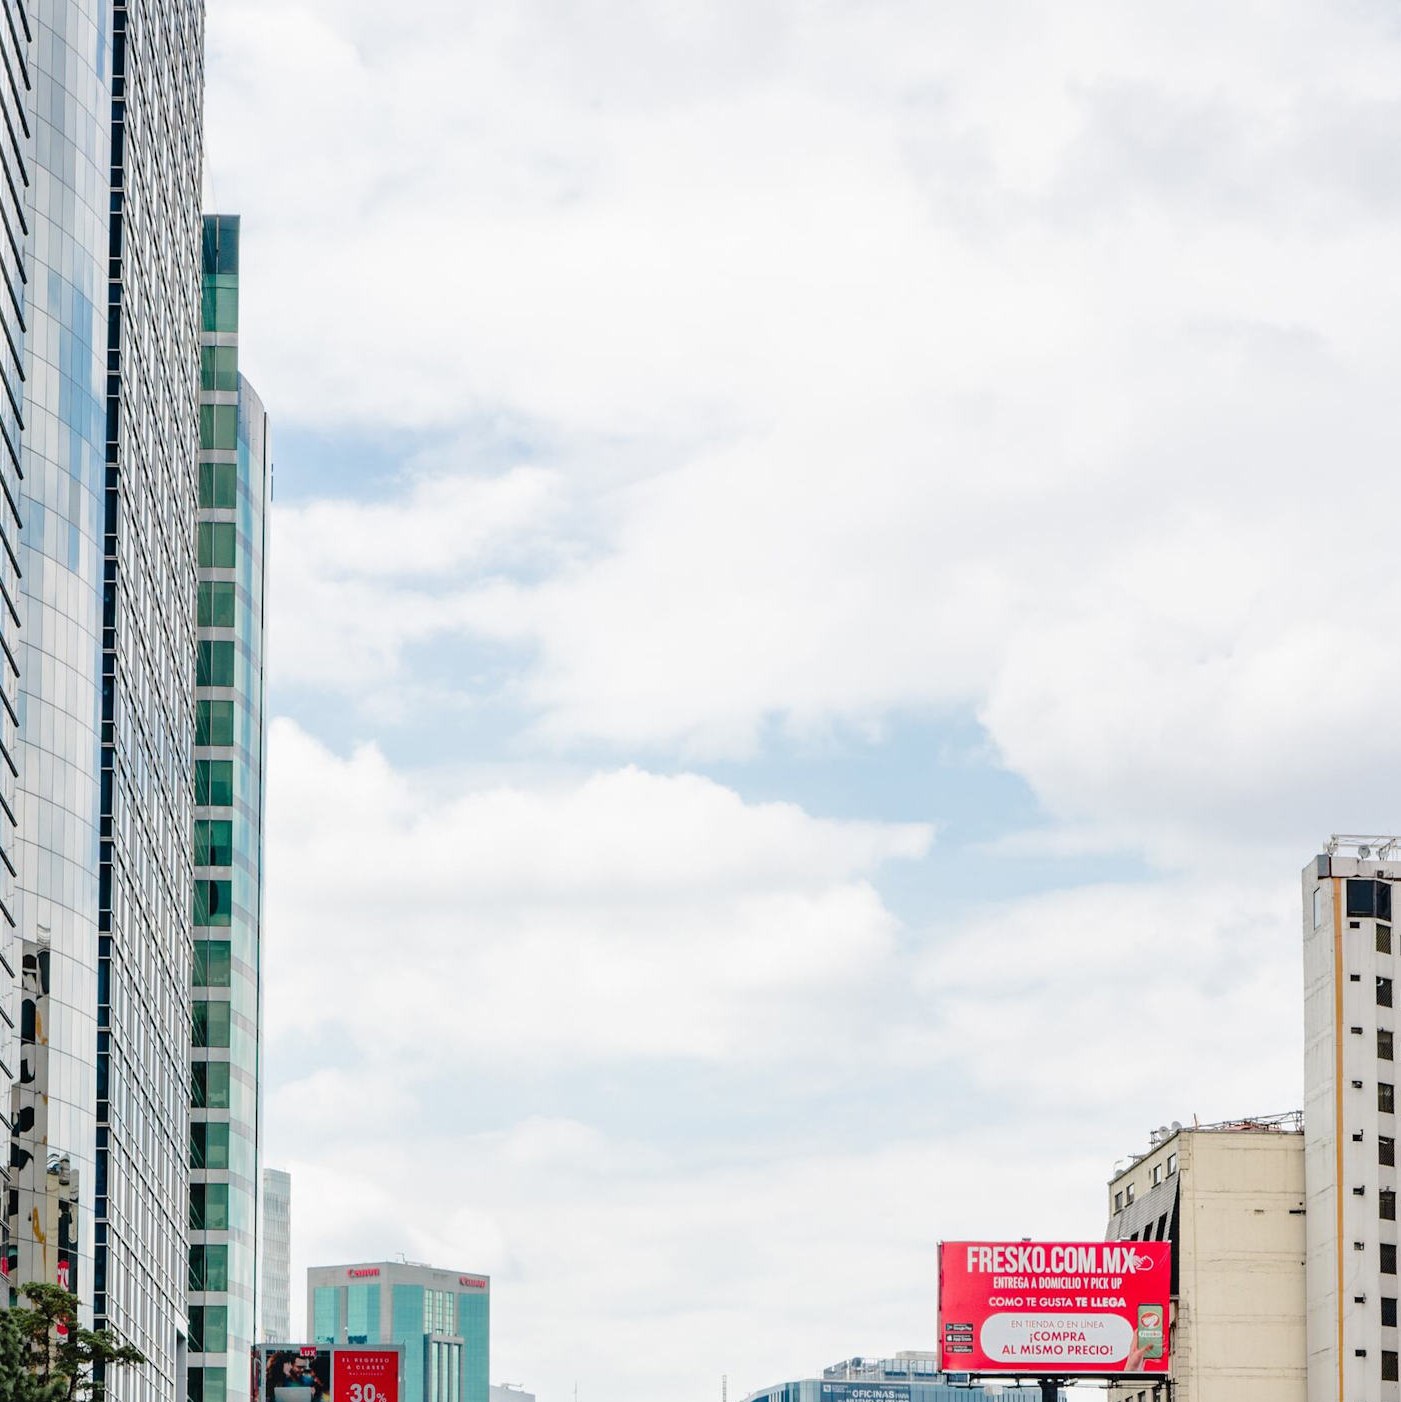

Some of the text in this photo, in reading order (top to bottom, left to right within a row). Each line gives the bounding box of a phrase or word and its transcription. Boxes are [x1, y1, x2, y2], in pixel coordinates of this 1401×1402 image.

[967, 1246, 1135, 1274] FRESKO.COM.MX
[993, 1276, 1122, 1290] ENTREGA A DOMICILIO Y PICK UP
[988, 1297, 1126, 1308] COMO TE GUSTA TE LLEGA
[1011, 1319, 1104, 1329] EN TIENDA O EN LÍNEA
[1029, 1331, 1086, 1343] ¡COMPRA
[1002, 1345, 1113, 1355] AL MISMO PRECIO!
[852, 1390, 894, 1399] OFICINAS
